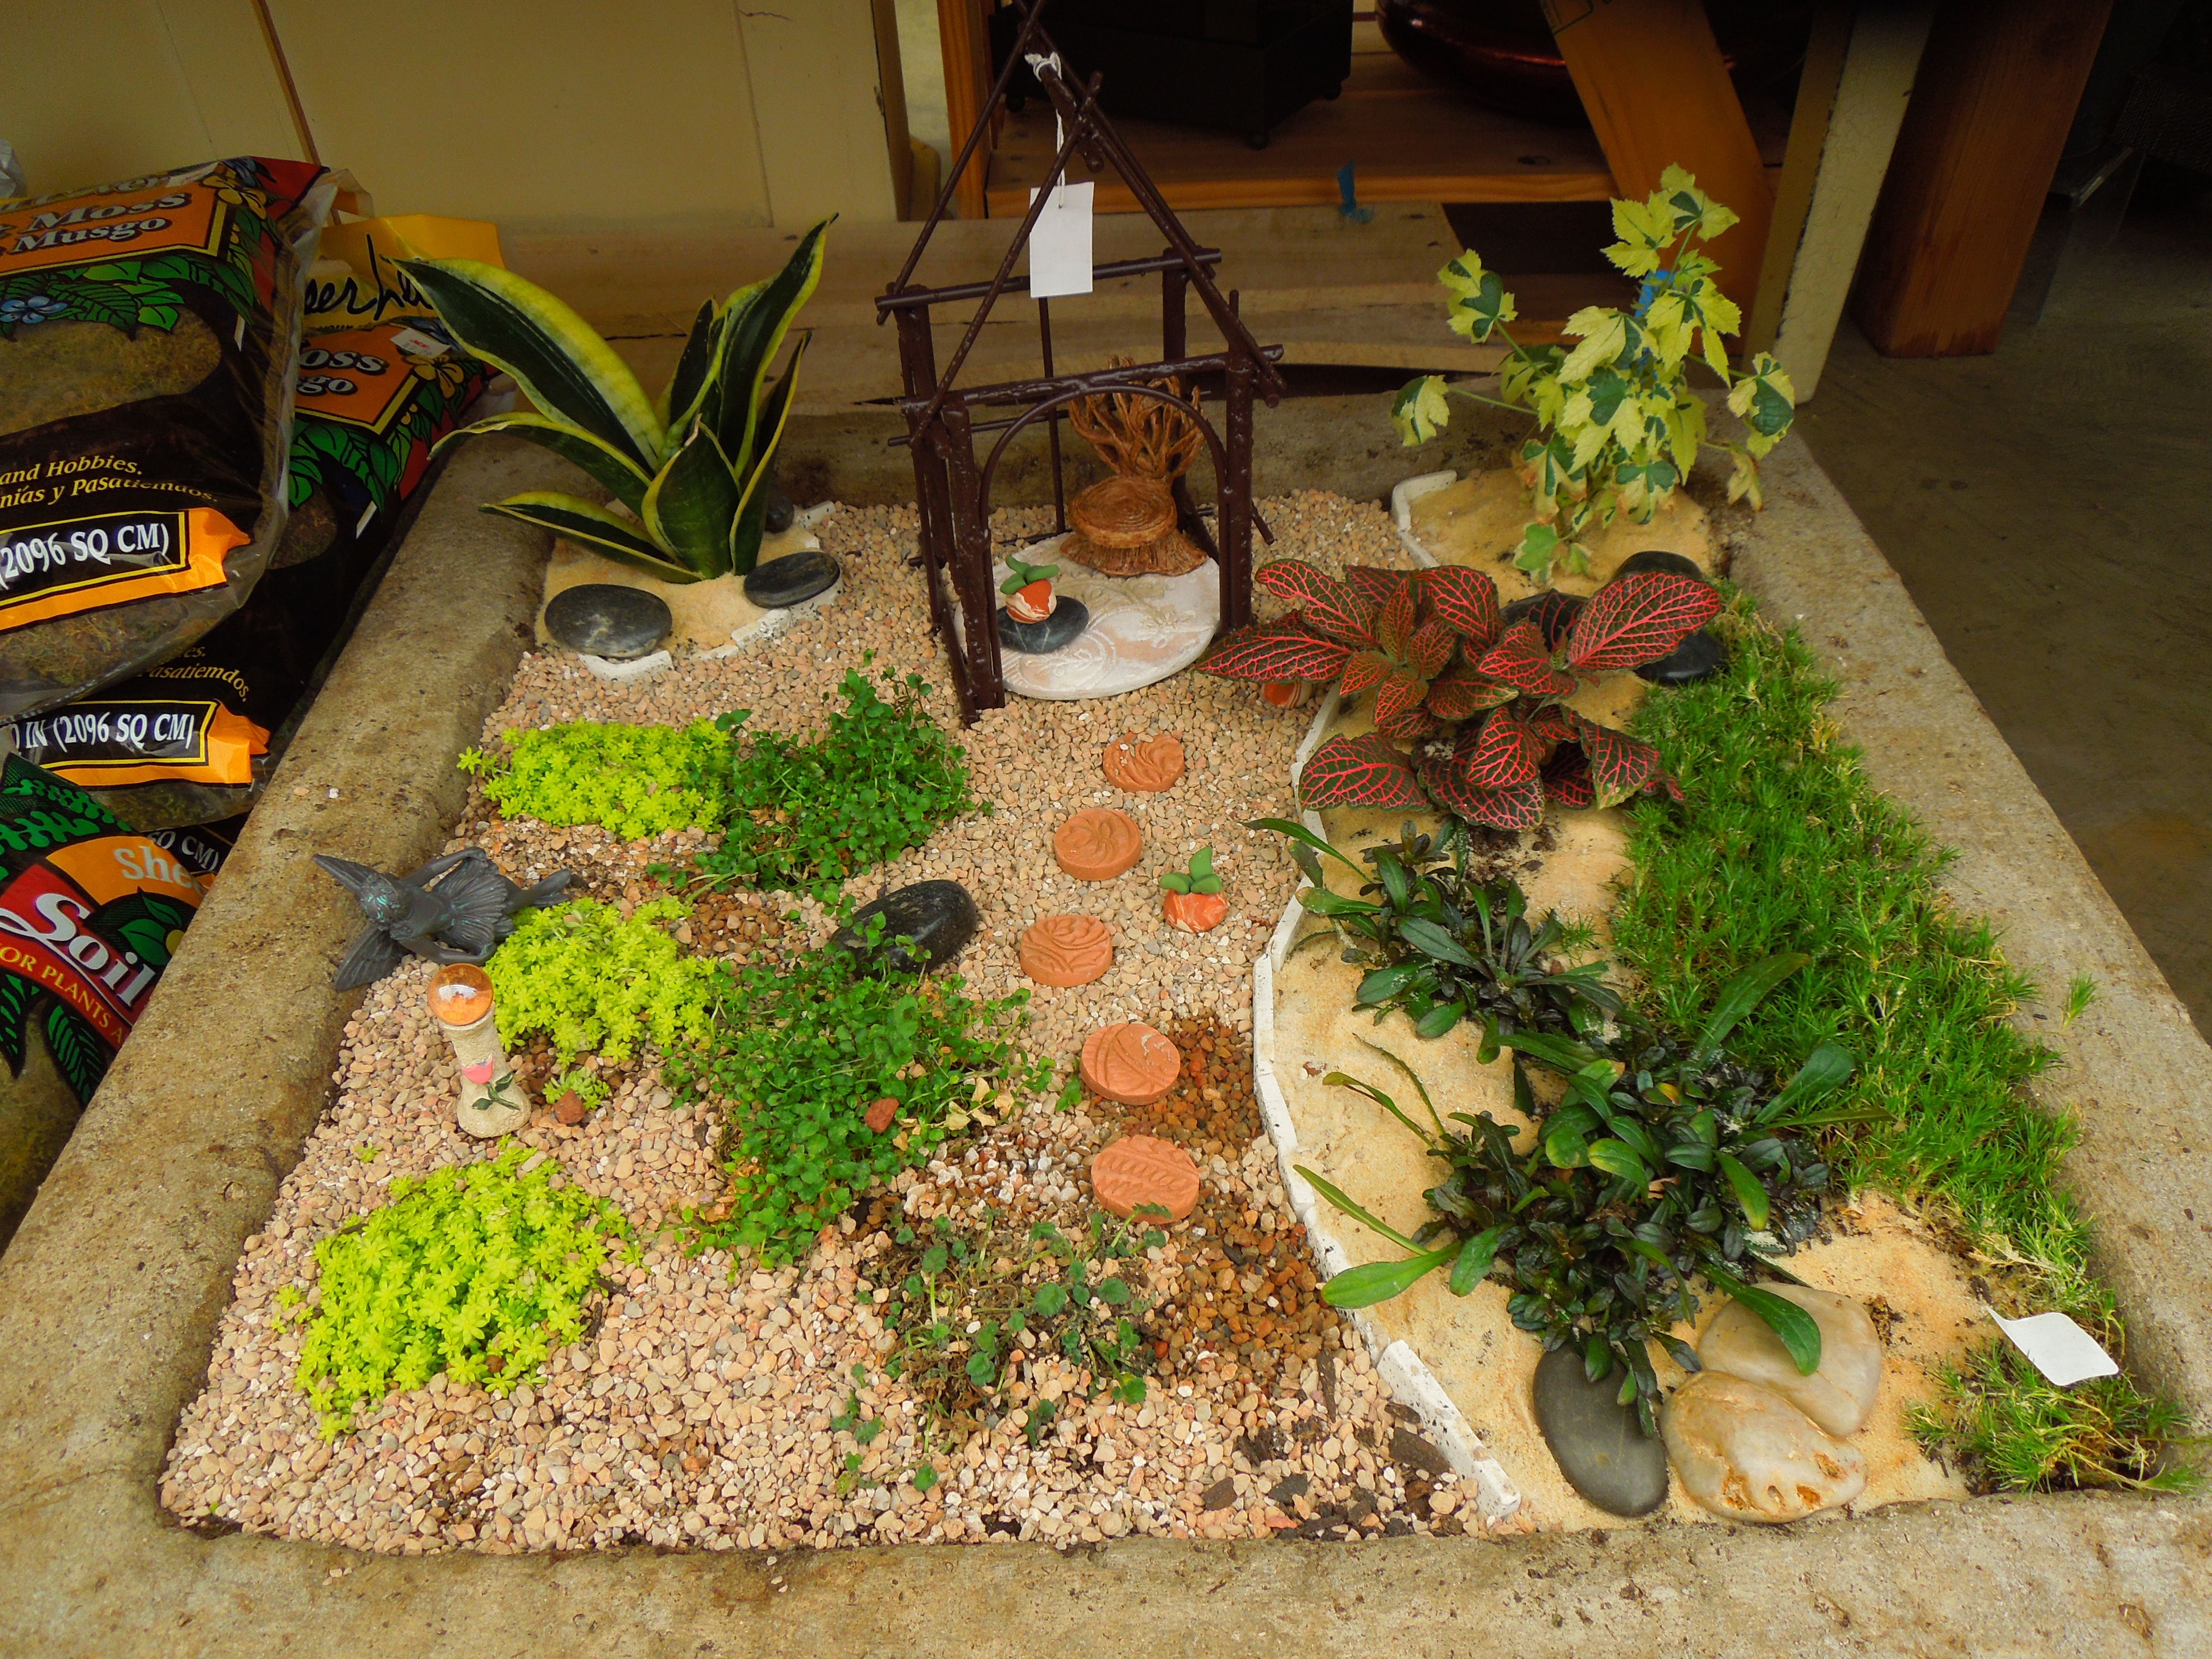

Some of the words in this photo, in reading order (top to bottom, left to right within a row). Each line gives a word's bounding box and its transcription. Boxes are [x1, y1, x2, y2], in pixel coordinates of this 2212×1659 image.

[17, 193, 191, 232] Moss
[8, 218, 170, 253] Musgo
[299, 349, 388, 374] oss
[296, 375, 355, 395] go
[0, 463, 41, 485] and
[46, 455, 143, 477] Hobbies.
[47, 485, 65, 506] y
[71, 529, 111, 565] SQ
[117, 523, 169, 556] CM)
[184, 646, 206, 658] es.
[137, 663, 250, 703] asatiemdos.
[25, 720, 48, 750] IN
[53, 711, 110, 753] (2096
[116, 713, 148, 749] SQ
[154, 714, 194, 749] CM)
[113, 845, 196, 894] She
[181, 836, 219, 871] CM)
[35, 892, 156, 1007] Soil
[0, 946, 37, 972] OR
[41, 965, 111, 1028] PLANTS
